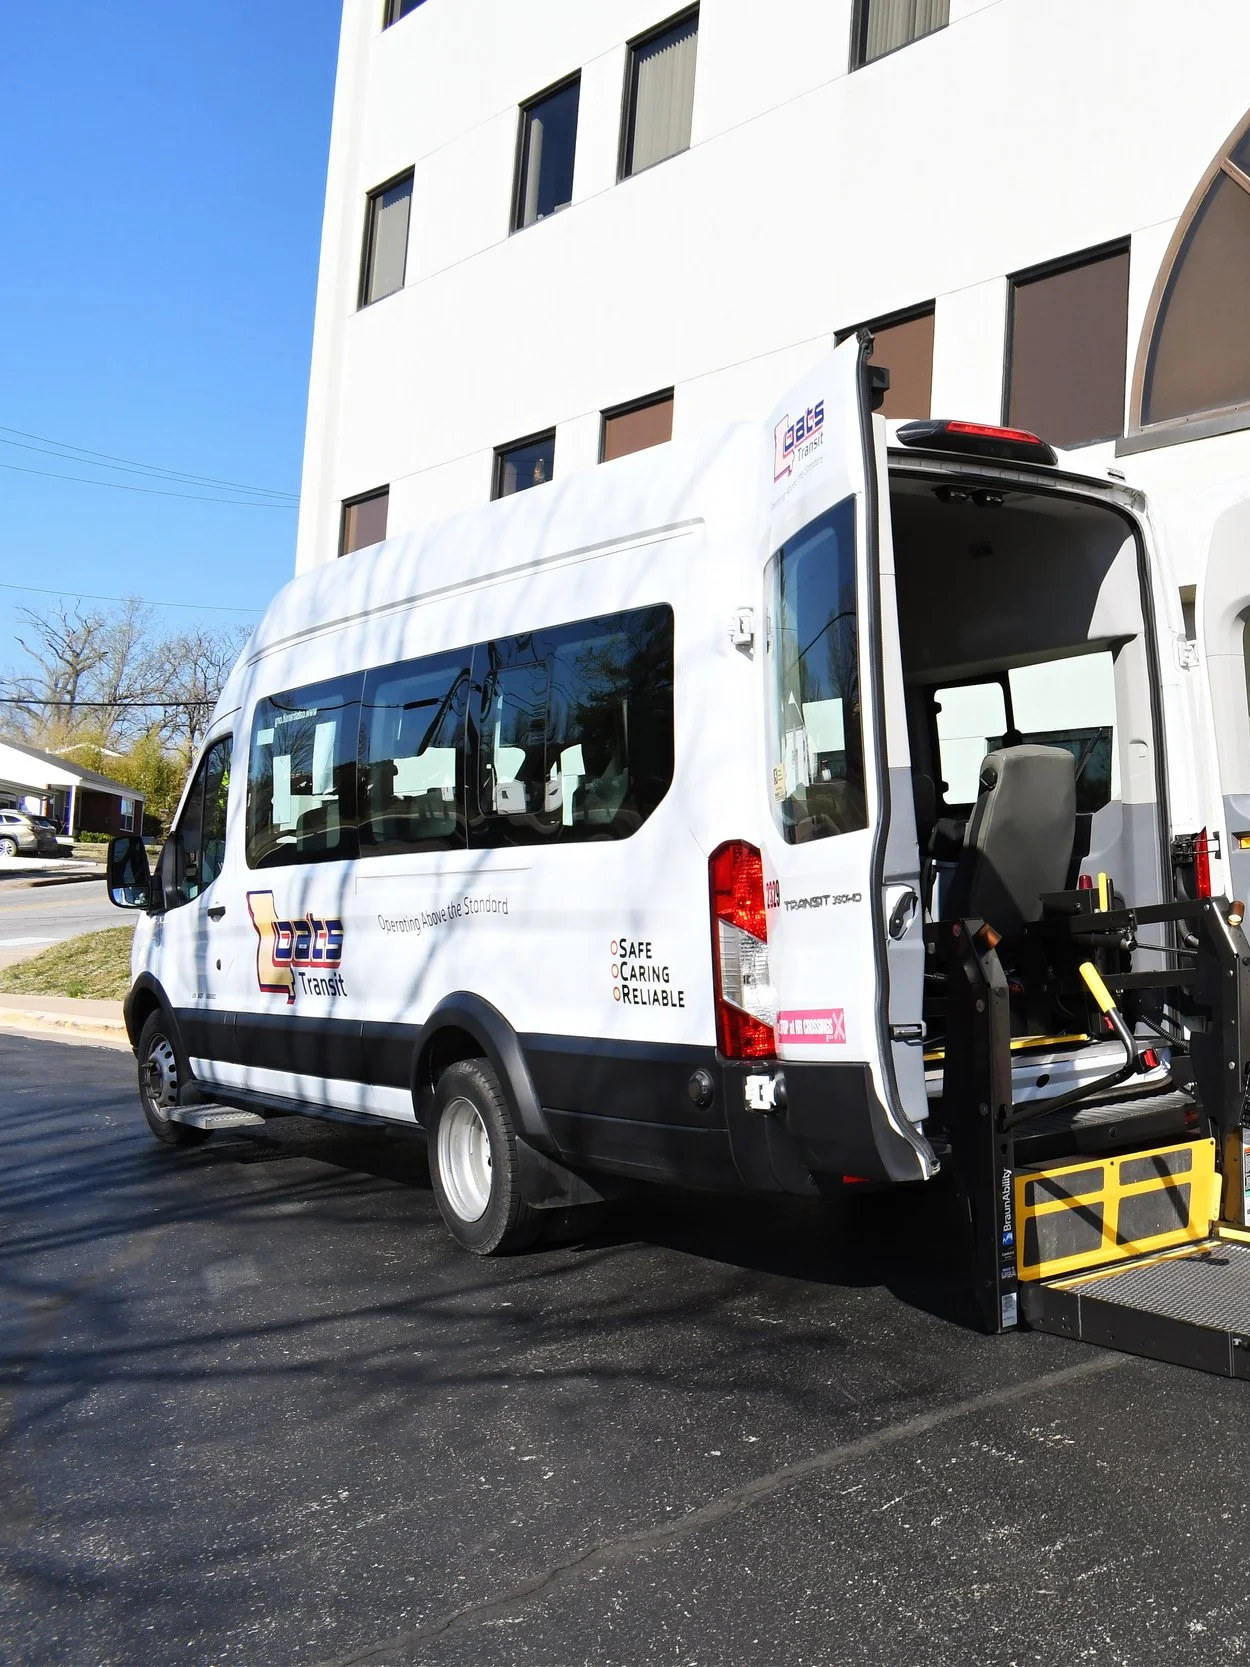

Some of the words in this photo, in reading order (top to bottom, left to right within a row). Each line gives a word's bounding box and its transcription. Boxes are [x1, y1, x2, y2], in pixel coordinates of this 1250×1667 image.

[797, 432, 823, 461] Transit
[377, 914, 421, 936] Operating
[421, 910, 447, 926] Above
[447, 901, 461, 919] the
[463, 894, 508, 915] Standard
[784, 895, 830, 911] TRANSIT
[298, 971, 347, 997] Transit
[1002, 1168, 1012, 1232] BraunAbility
